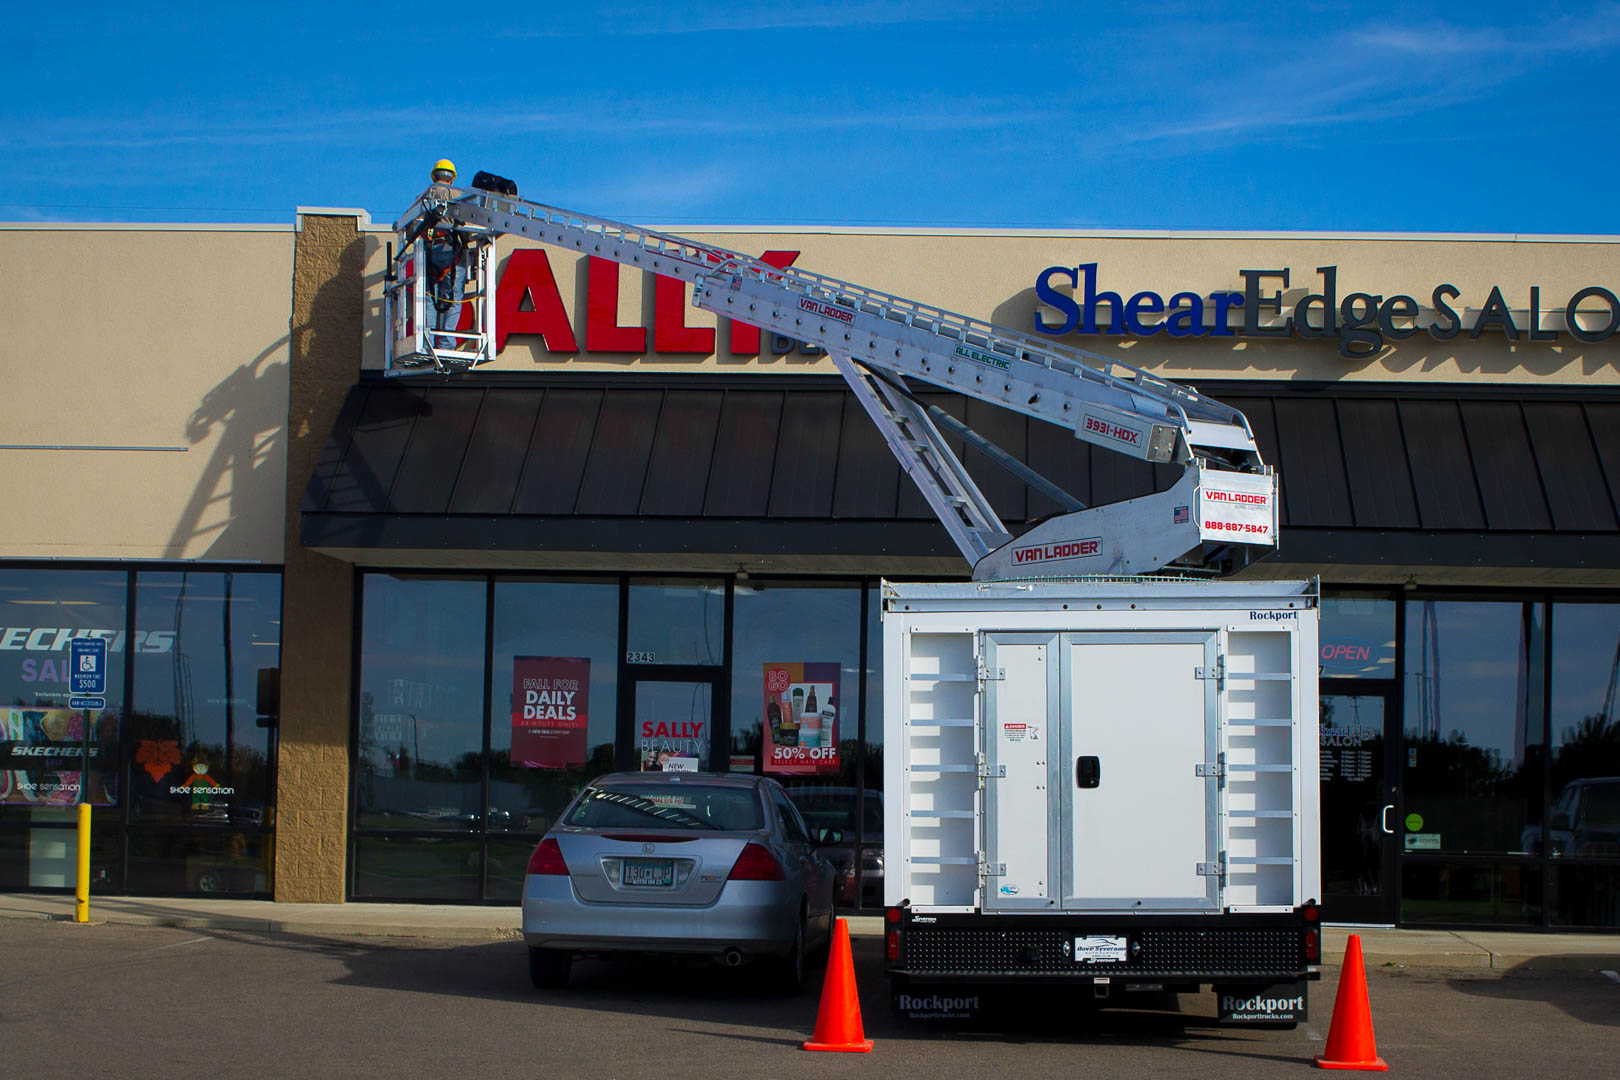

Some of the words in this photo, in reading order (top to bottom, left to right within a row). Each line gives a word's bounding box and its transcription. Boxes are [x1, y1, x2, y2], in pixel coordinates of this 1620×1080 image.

[800, 298, 819, 312] VAN
[819, 304, 854, 323] LADDER
[1428, 284, 1620, 342] SALO
[955, 346, 970, 357] ALL
[971, 351, 1010, 369] ELECTRIC
[1085, 418, 1139, 444] 3931-HDX
[1205, 491, 1227, 501] VAN
[1228, 493, 1267, 504] LADDER
[1204, 521, 1269, 534] 888-887-5847
[1015, 548, 1042, 562] VAN
[1044, 541, 1098, 559] LADDER
[1249, 611, 1297, 621] Rockport
[627, 652, 655, 663] 2343
[1321, 645, 1371, 660] OPEN
[21, 659, 70, 682] SAL
[79, 680, 96, 688] $500
[523, 678, 551, 690] FALL
[553, 678, 579, 691] FOR
[526, 690, 576, 706] DAILY
[523, 705, 577, 721] DEALS
[641, 721, 705, 739] SALLY
[641, 739, 704, 753] BEAUTY
[1320, 736, 1362, 747] SALON
[774, 747, 805, 759] 50%
[809, 747, 836, 760] OFF
[899, 994, 980, 1013] Rockport
[1223, 995, 1304, 1013] Rockport
